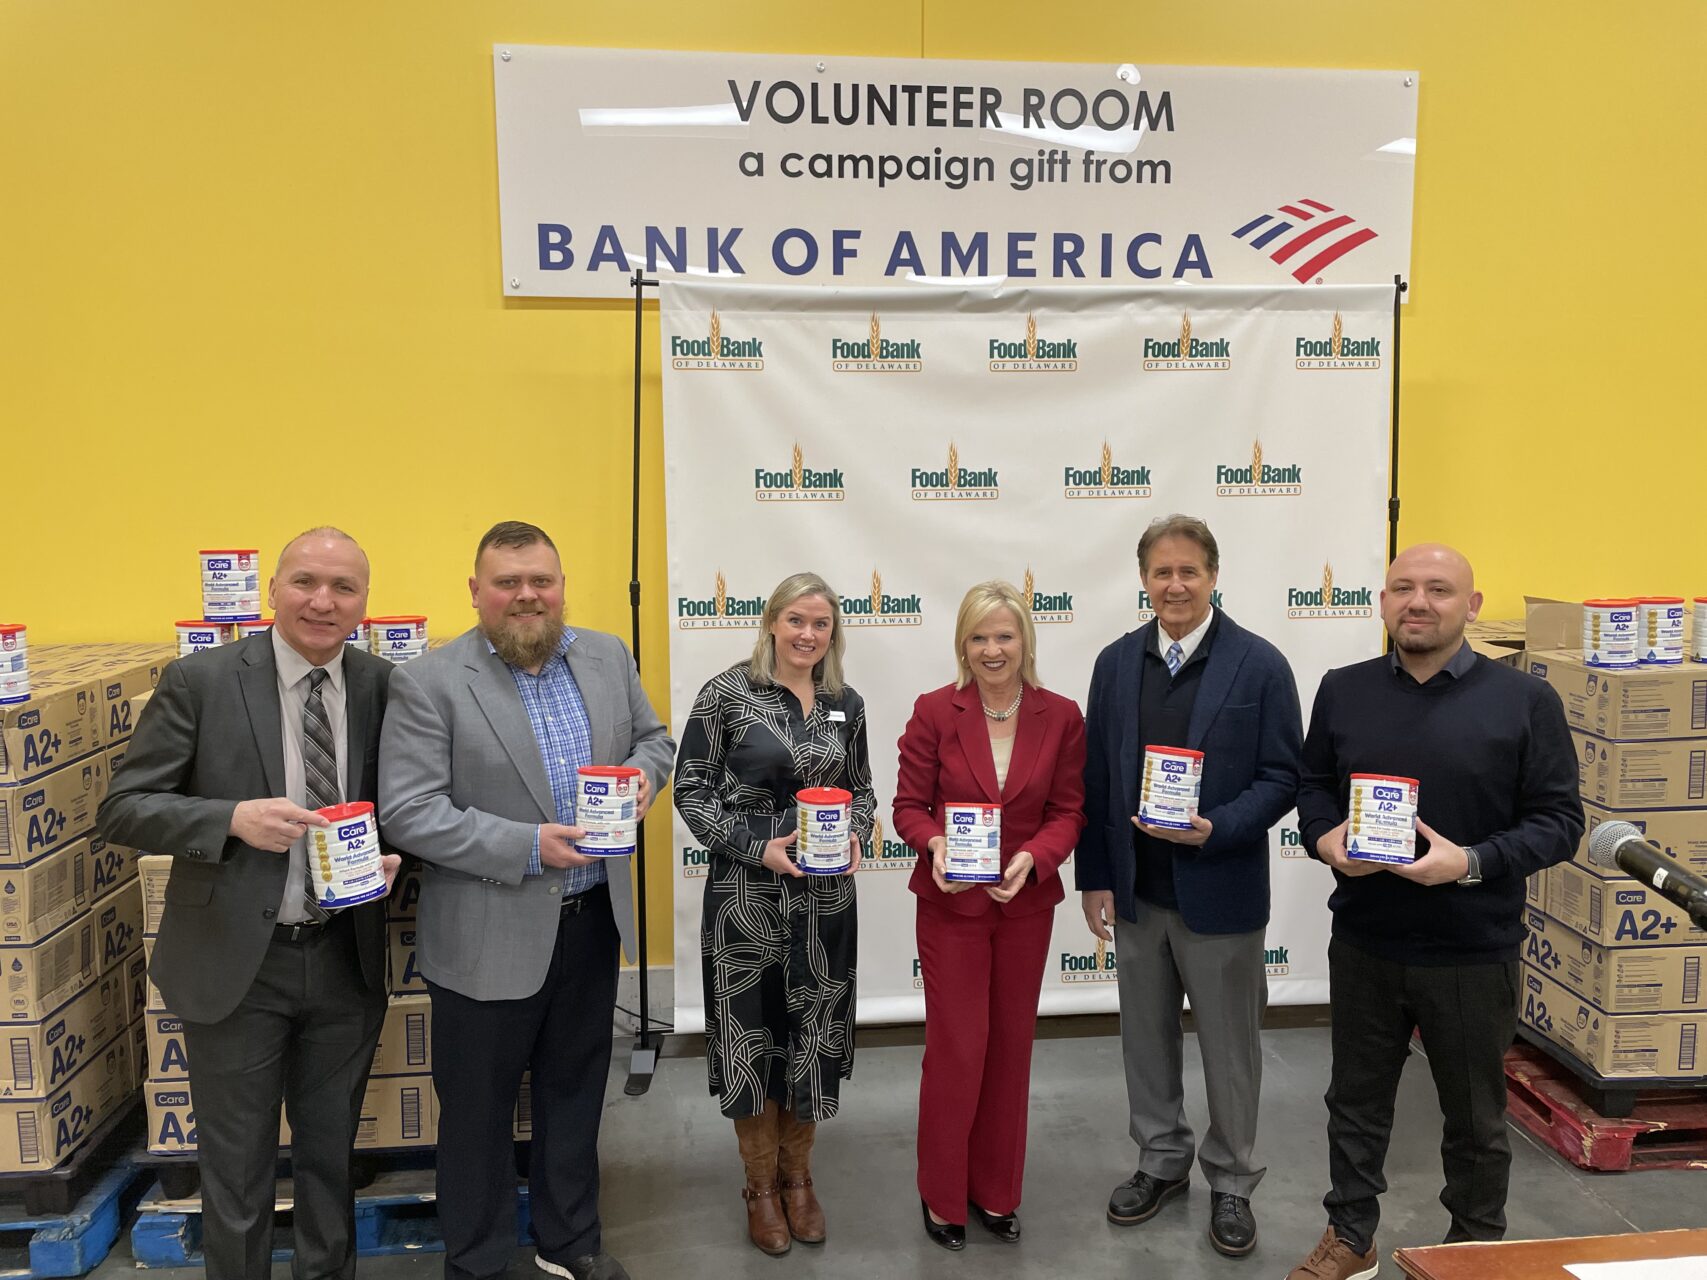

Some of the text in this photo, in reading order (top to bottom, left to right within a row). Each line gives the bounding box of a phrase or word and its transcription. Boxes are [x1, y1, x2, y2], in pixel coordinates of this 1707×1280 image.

[727, 79, 1174, 132] VOLUNTEER ROOM
[738, 147, 1172, 191] a campaign gift from
[537, 223, 1214, 279] BANK OF AMERICA
[719, 336, 763, 358] Bank
[879, 339, 921, 359] Bank
[1036, 338, 1077, 359] Bank
[1189, 338, 1230, 358] Bank
[1341, 337, 1380, 357] Bank
[676, 360, 761, 369] OF DELAWARE
[836, 362, 918, 371] OF DELAWARE
[993, 362, 1074, 371] OF DELAWARE
[1146, 361, 1227, 369] OF DELAWARE
[1299, 360, 1377, 368] OF DELAWARE
[802, 468, 844, 489] Bank
[957, 468, 998, 488] Bank
[1111, 466, 1151, 486] Bank
[1261, 464, 1301, 484] Bank
[760, 492, 841, 500] OF DELAWARE
[915, 490, 995, 499] OF DELAWARE
[1068, 489, 1148, 497] OF DELAWARE
[1220, 487, 1298, 496] OF DELAWARE
[209, 561, 229, 569] Care
[212, 571, 228, 580] A2+
[1032, 591, 1073, 611] Bank
[1331, 586, 1372, 606] Bank
[880, 594, 921, 614] Bank
[1615, 623, 1629, 631] A2+
[190, 634, 212, 642] Care
[388, 631, 408, 639] Care
[108, 686, 121, 697] Care
[20, 714, 39, 726] Care
[23, 728, 62, 771] A2+
[1164, 762, 1184, 772] Care
[1165, 773, 1182, 783] A2+
[586, 783, 606, 793] Care
[25, 795, 43, 807] Care
[587, 796, 604, 806] A2+
[1378, 801, 1398, 812] A2+
[818, 812, 839, 820] Care
[954, 815, 974, 823] Care
[27, 807, 66, 852] A2+
[341, 826, 365, 838] Care
[821, 822, 836, 831] A2+
[956, 826, 971, 834] A2+
[1281, 828, 1303, 846] Fo
[347, 839, 365, 851] A2+
[683, 847, 710, 866] Foo
[861, 861, 914, 869] DELAWAR
[94, 851, 124, 893] A2+
[1618, 893, 1643, 902] Care
[1615, 909, 1677, 941] A2+
[104, 921, 134, 965] A2+
[1527, 931, 1561, 971] A2+
[1528, 976, 1541, 992] Care
[1525, 993, 1554, 1032] A2+
[161, 1021, 183, 1031] Car
[48, 1025, 64, 1042] Care
[50, 1034, 86, 1084] A2+
[158, 1095, 185, 1104] Care
[53, 1098, 70, 1114] Care
[55, 1104, 93, 1157] A2+
[159, 1112, 199, 1144] A2
